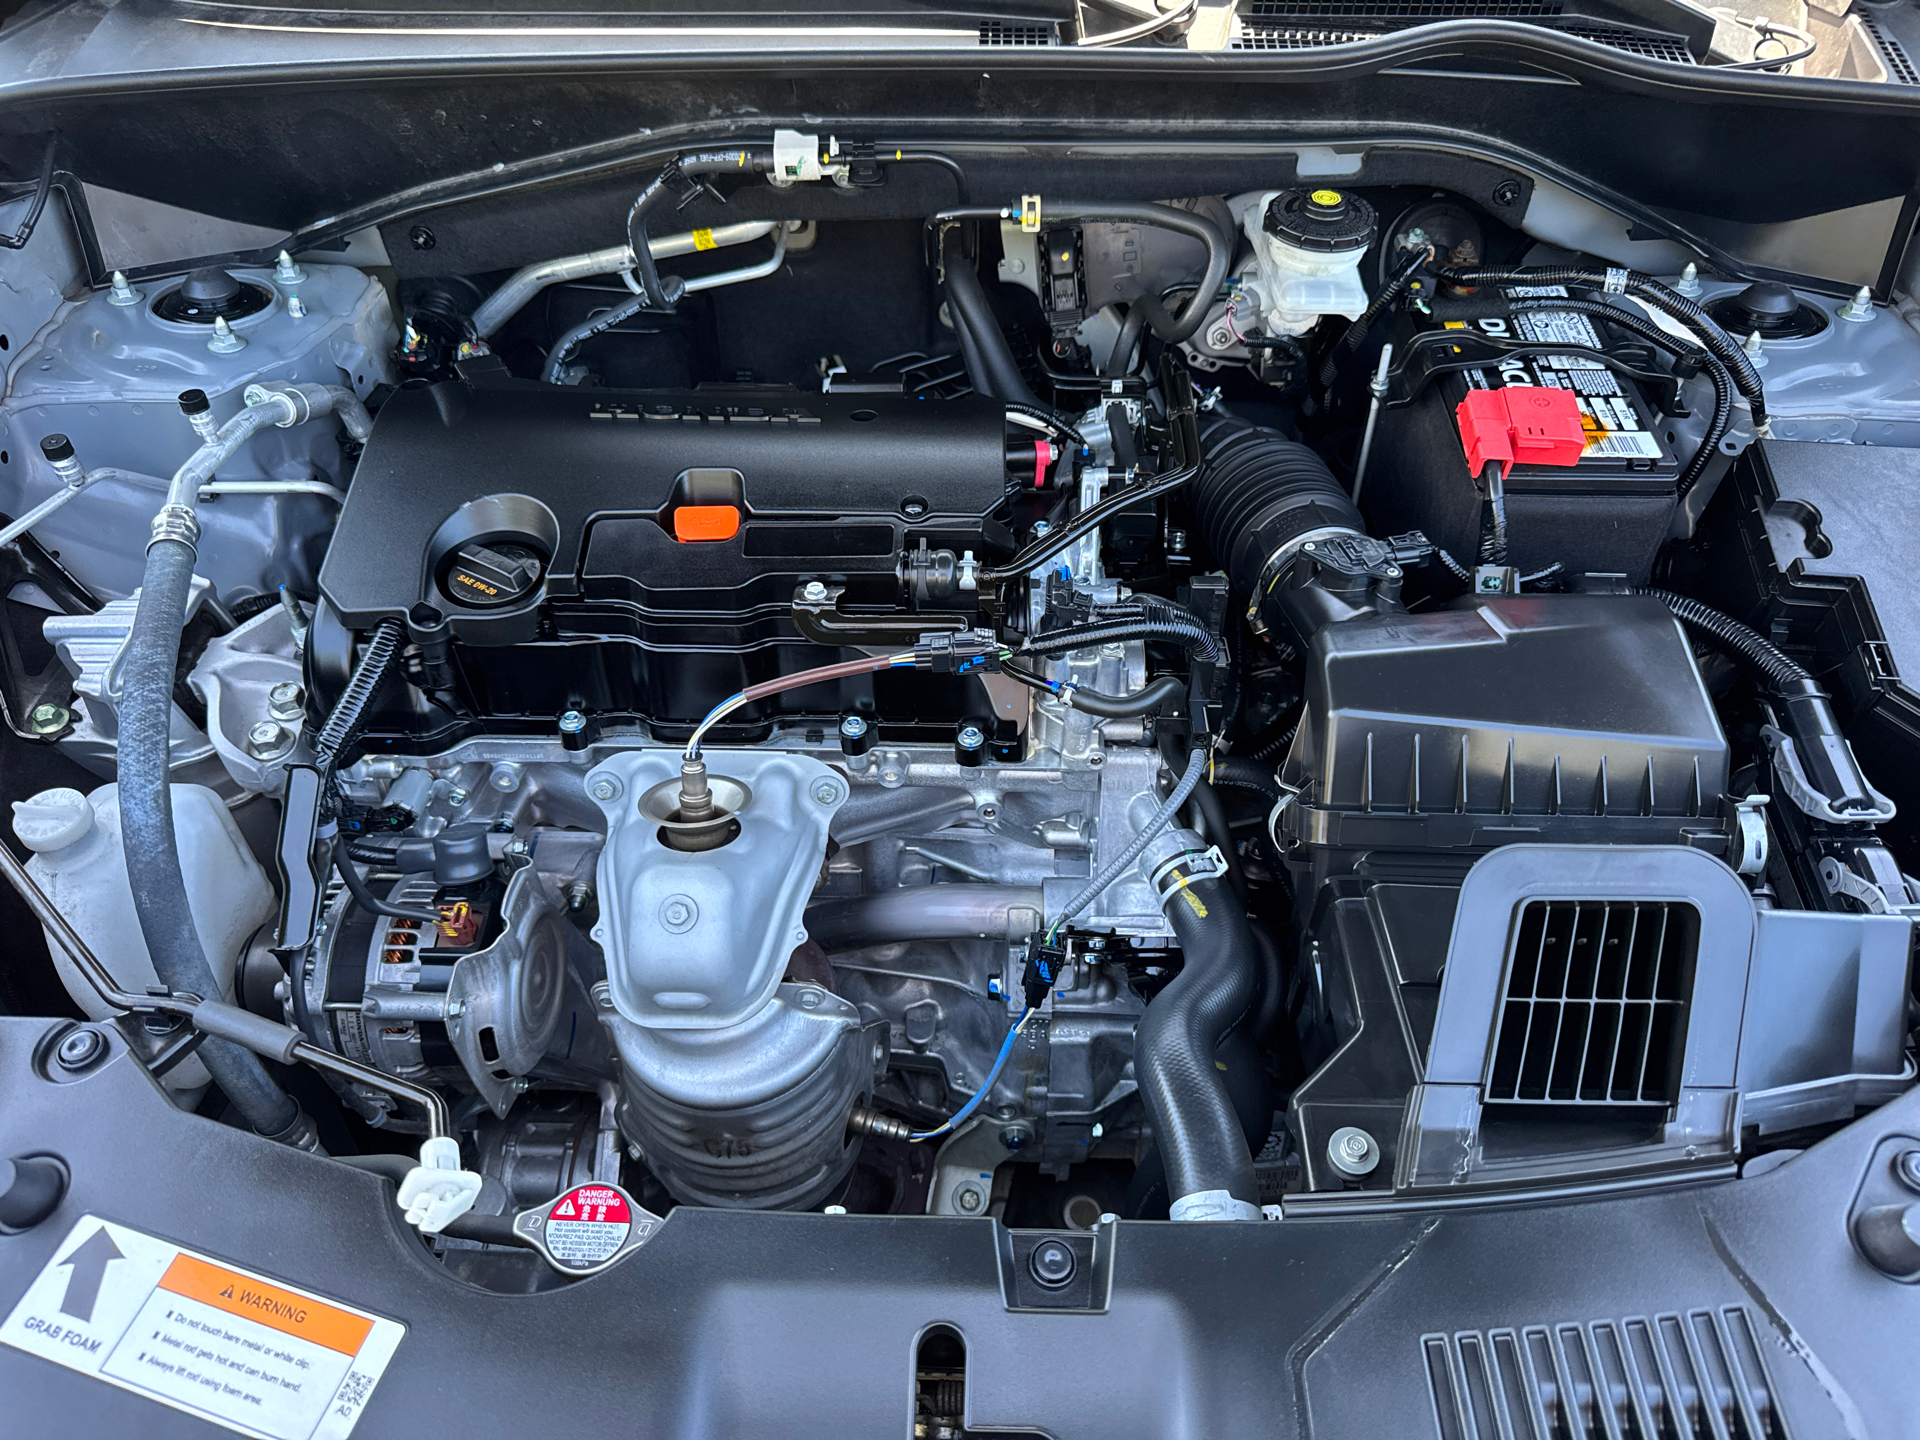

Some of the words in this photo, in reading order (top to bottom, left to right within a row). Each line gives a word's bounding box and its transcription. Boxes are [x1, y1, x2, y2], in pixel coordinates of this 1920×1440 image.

[457, 574, 476, 586] SAE
[472, 581, 498, 596] 0W-20
[577, 1197, 620, 1206] WARNUNG
[579, 1189, 614, 1198] DANGER
[239, 1290, 308, 1324] WARNING
[24, 1316, 63, 1339] GRAB
[60, 1330, 103, 1354] FOAM
[174, 1312, 187, 1324] Do
[187, 1318, 202, 1330] not
[201, 1322, 223, 1337] touch
[222, 1330, 241, 1344] bare
[241, 1337, 265, 1352] metal
[263, 1346, 274, 1356] or
[273, 1350, 295, 1364] white
[295, 1356, 311, 1370] clip.
[146, 1355, 175, 1373] Always
[174, 1364, 188, 1376] lift
[186, 1371, 201, 1383] rod
[199, 1375, 222, 1392] using
[221, 1383, 243, 1398] foam
[161, 1333, 185, 1350] Metal
[183, 1341, 199, 1354] rod
[196, 1348, 215, 1362] gets
[214, 1353, 229, 1366] hot
[228, 1359, 246, 1372] and
[244, 1365, 260, 1377] can
[260, 1370, 280, 1384] burn
[279, 1378, 302, 1393] hand.
